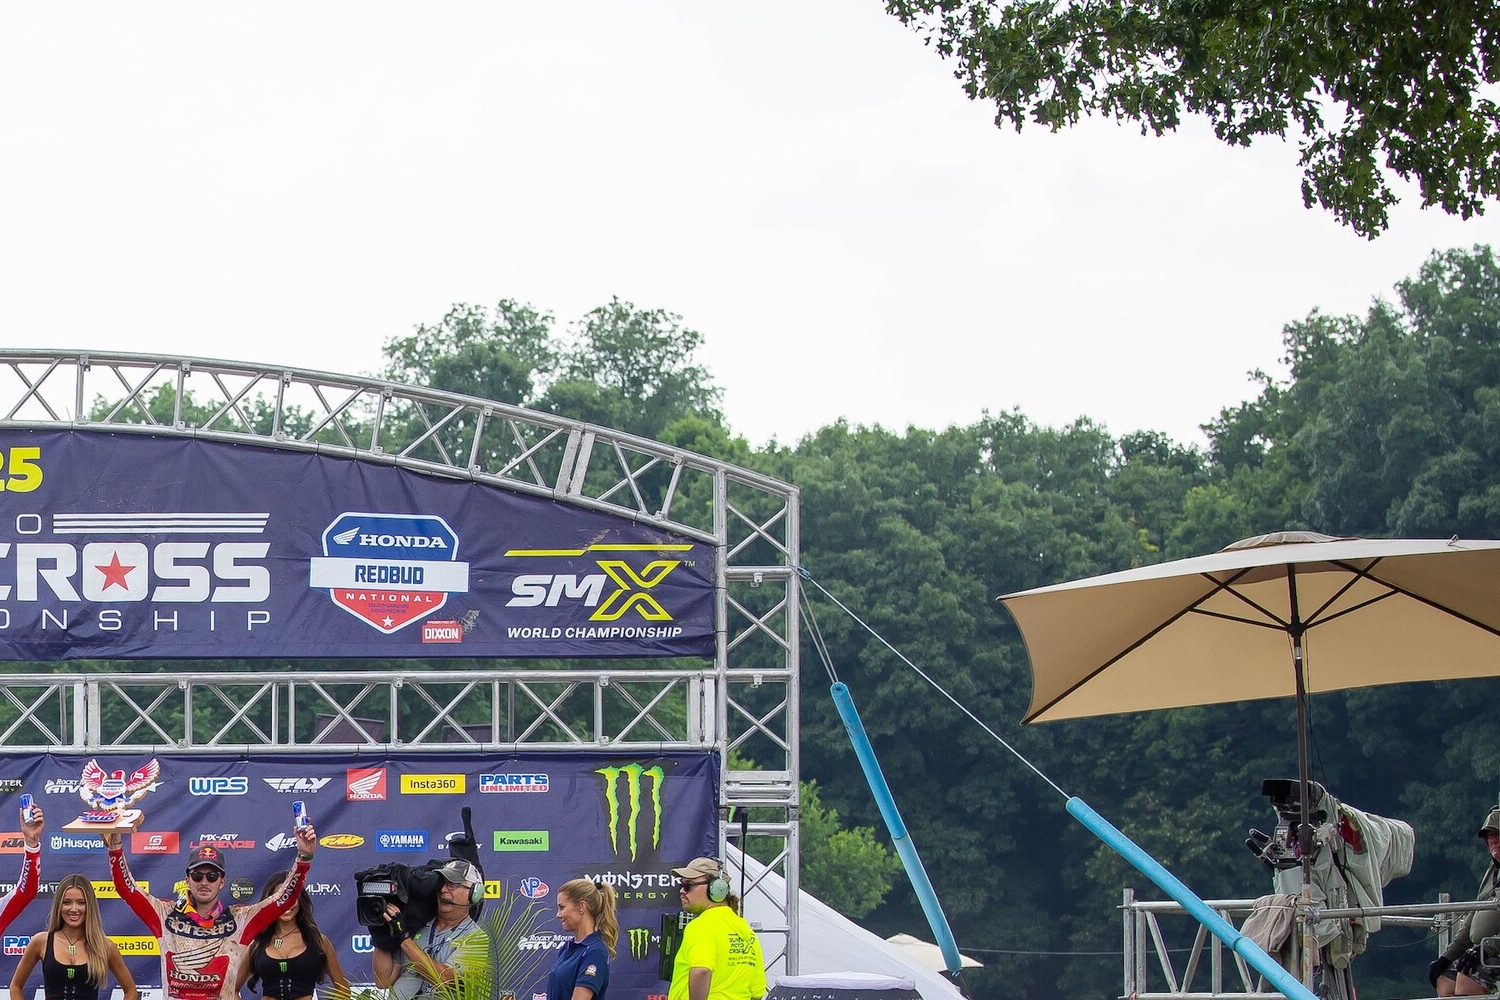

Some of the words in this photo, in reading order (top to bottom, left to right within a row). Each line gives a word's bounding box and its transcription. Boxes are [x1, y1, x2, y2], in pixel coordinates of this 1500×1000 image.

[359, 533, 448, 549] HONDA
[355, 564, 424, 585] REDBUD
[505, 560, 681, 622] SMX
[345, 592, 433, 603] NATIONAL
[425, 626, 459, 640] DIXXON
[507, 627, 561, 640] WORLD
[564, 626, 683, 640] CHAMPIONSHIP
[410, 779, 456, 789] Insta360
[480, 773, 548, 785] PARTS
[190, 777, 248, 795] WPS
[480, 784, 548, 792] UNLIMITED
[119, 809, 141, 828] 2
[200, 833, 239, 841] MX-ATV
[390, 835, 424, 845] YAMAHA
[500, 837, 542, 845] Kawasaki
[63, 838, 104, 849] Husqva
[189, 841, 256, 850] LEGENDS
[276, 872, 301, 908] HONDA
[168, 914, 235, 939] alpinestars
[169, 970, 222, 982] HONDA
